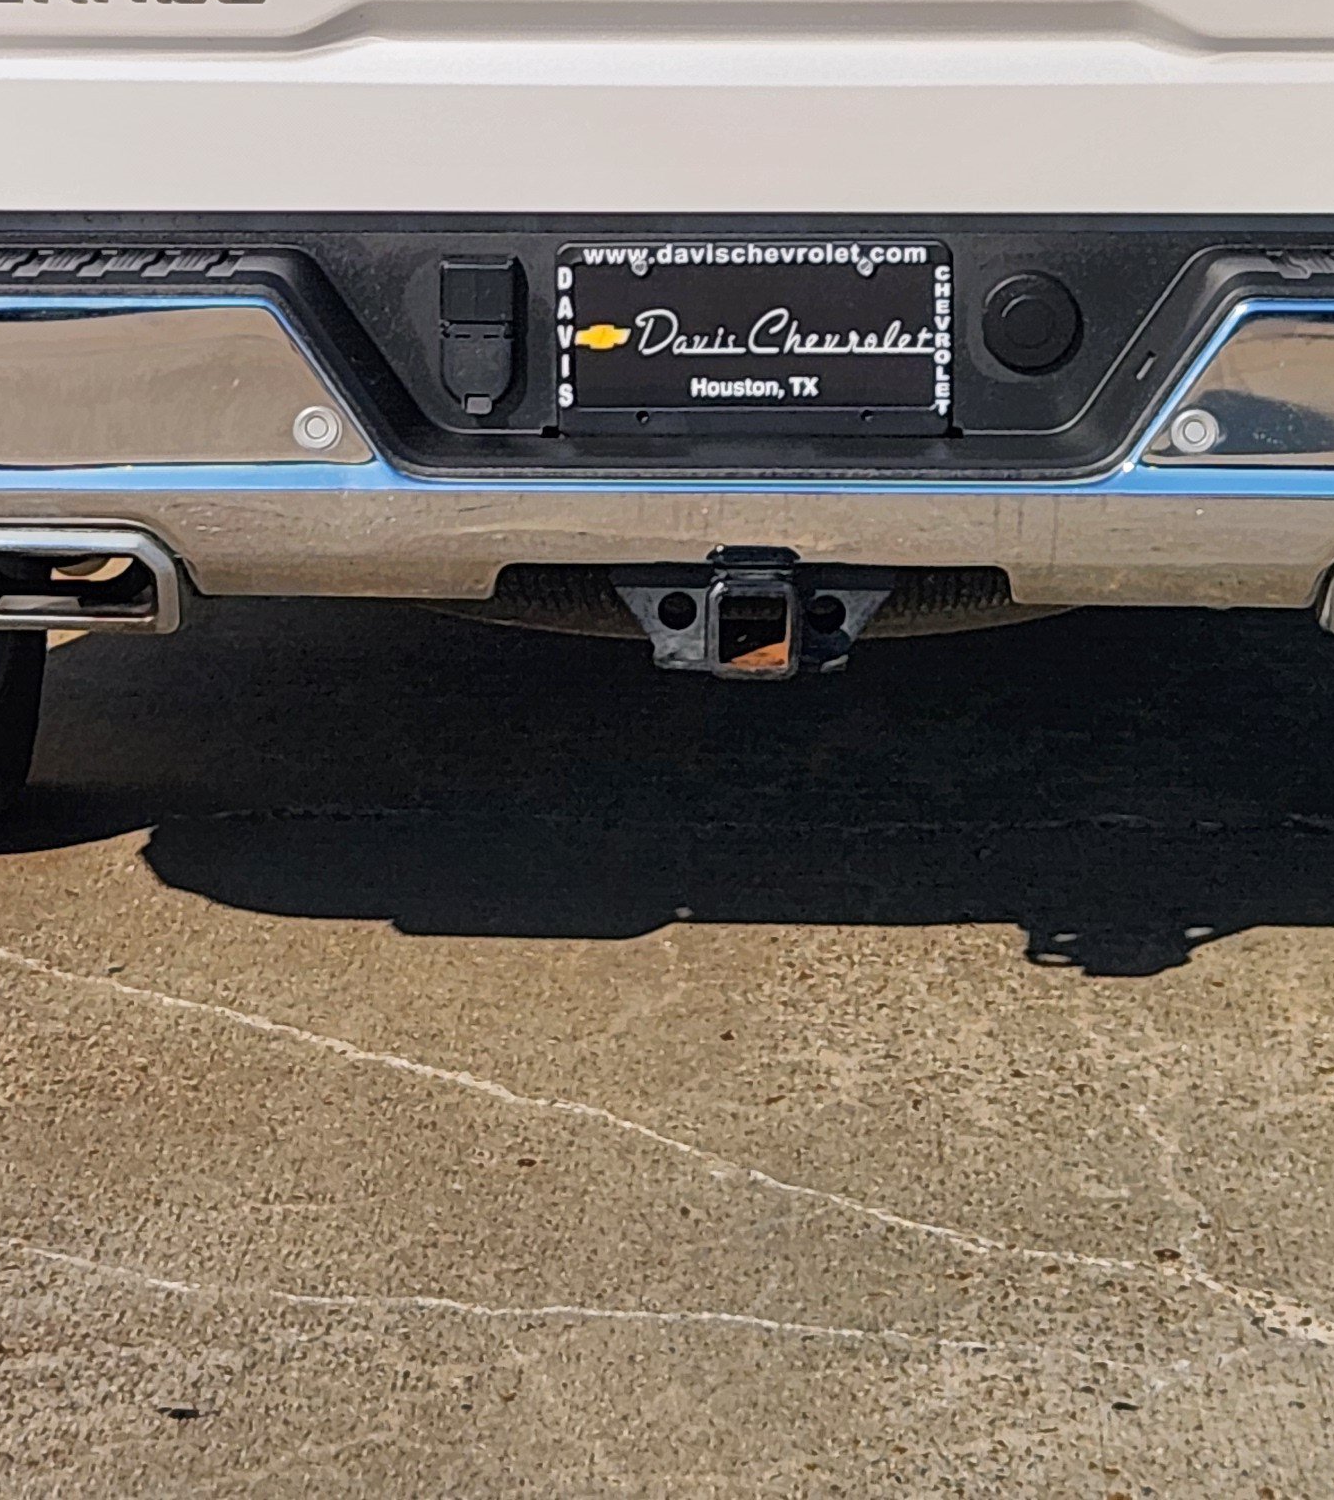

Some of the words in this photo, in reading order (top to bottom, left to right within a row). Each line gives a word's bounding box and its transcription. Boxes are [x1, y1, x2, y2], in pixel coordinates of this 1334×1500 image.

[556, 266, 574, 408] DAVIS
[635, 308, 747, 355] Davis
[747, 308, 935, 354] Chevrolet
[933, 265, 952, 416] CHEVROLET
[690, 377, 785, 398] Houston,
[788, 376, 820, 397] TX
